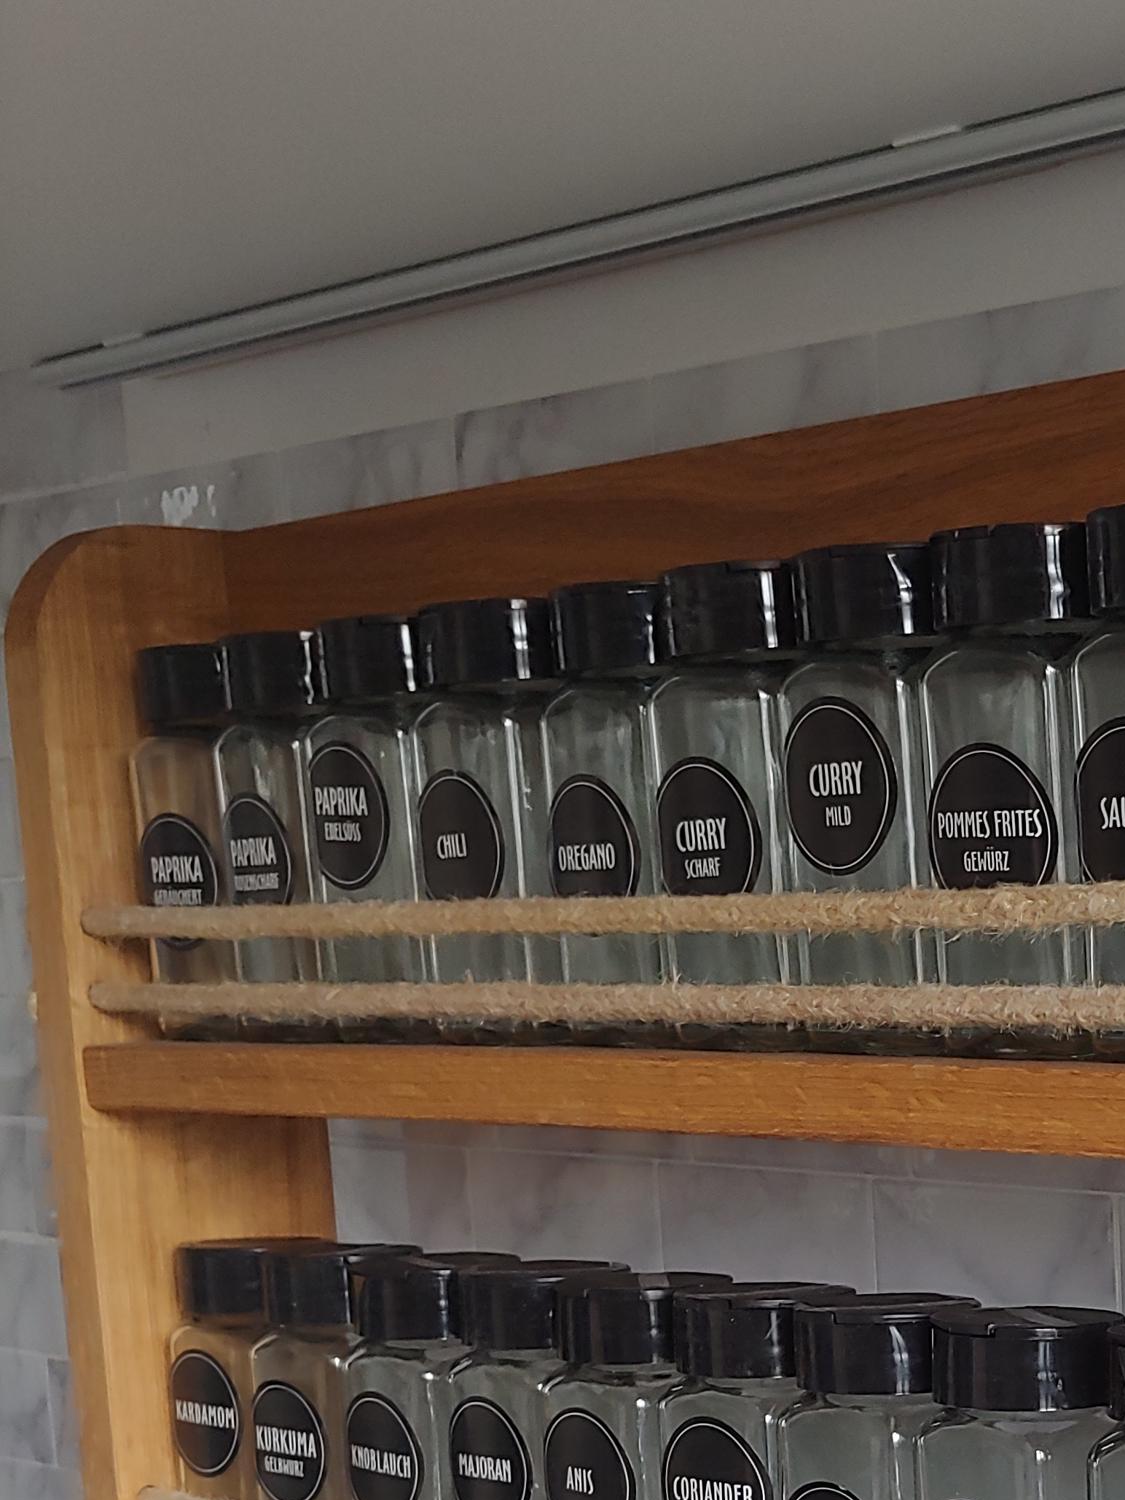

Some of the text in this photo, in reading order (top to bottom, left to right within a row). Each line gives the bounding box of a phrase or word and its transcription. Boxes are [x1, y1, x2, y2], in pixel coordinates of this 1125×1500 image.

[809, 760, 863, 797] CURRY
[314, 785, 368, 817] PAPRIKA
[825, 806, 852, 827] MILD
[675, 817, 726, 853] CURRY
[937, 808, 1043, 839] POMMES FRITES
[230, 836, 277, 867] PAPRIKA
[436, 834, 467, 860] CHILI
[557, 843, 616, 872] OREGANO
[963, 846, 1010, 873] GEWÜRZ
[150, 855, 204, 883] PAPRIKA
[685, 856, 721, 880] SCHARF
[175, 1399, 235, 1430] KARDAMOM
[256, 1424, 317, 1460] KURKUMA
[351, 1444, 411, 1480] KNOBLAUCH
[458, 1453, 512, 1484] MAJORAN
[566, 1465, 594, 1495] ANIS
